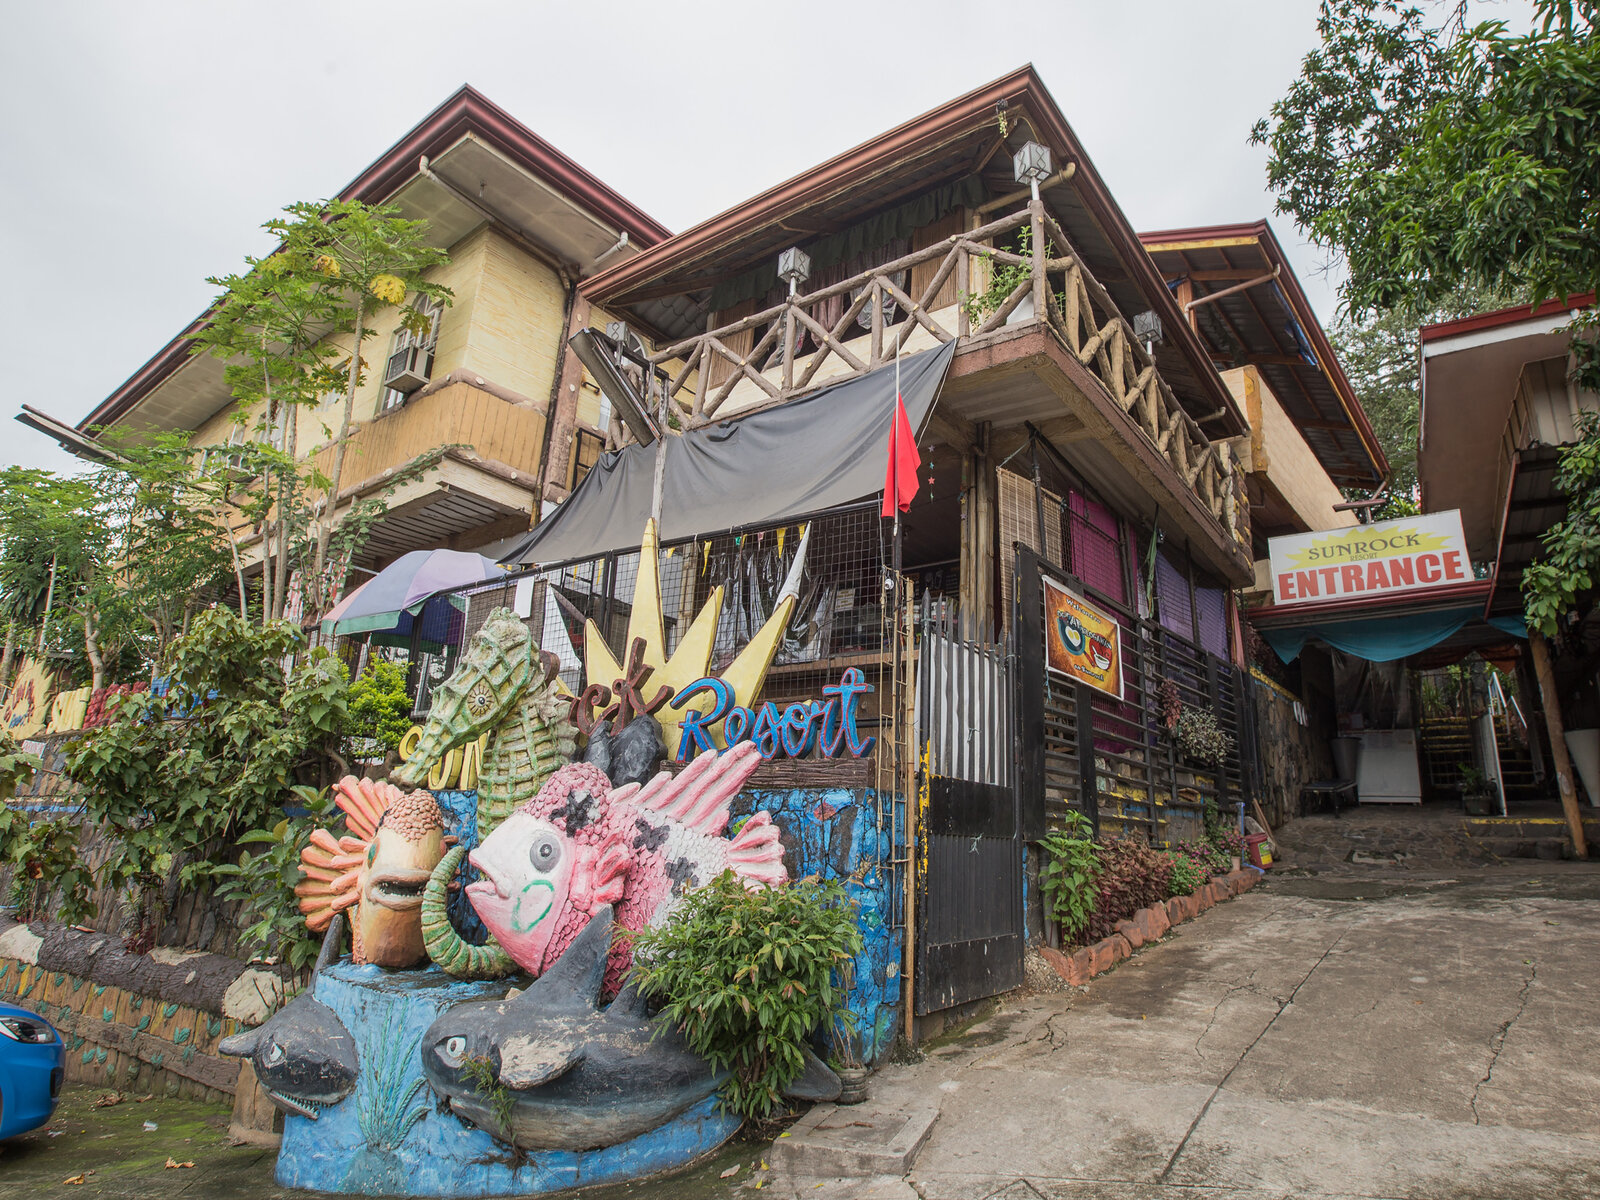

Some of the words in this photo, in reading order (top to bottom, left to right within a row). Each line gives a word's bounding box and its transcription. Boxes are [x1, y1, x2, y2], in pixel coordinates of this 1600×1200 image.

[1308, 534, 1422, 561] SUNROCK
[1350, 552, 1378, 562] RESORT
[1278, 550, 1465, 601] ENTRANCE
[670, 667, 876, 763] Resort
